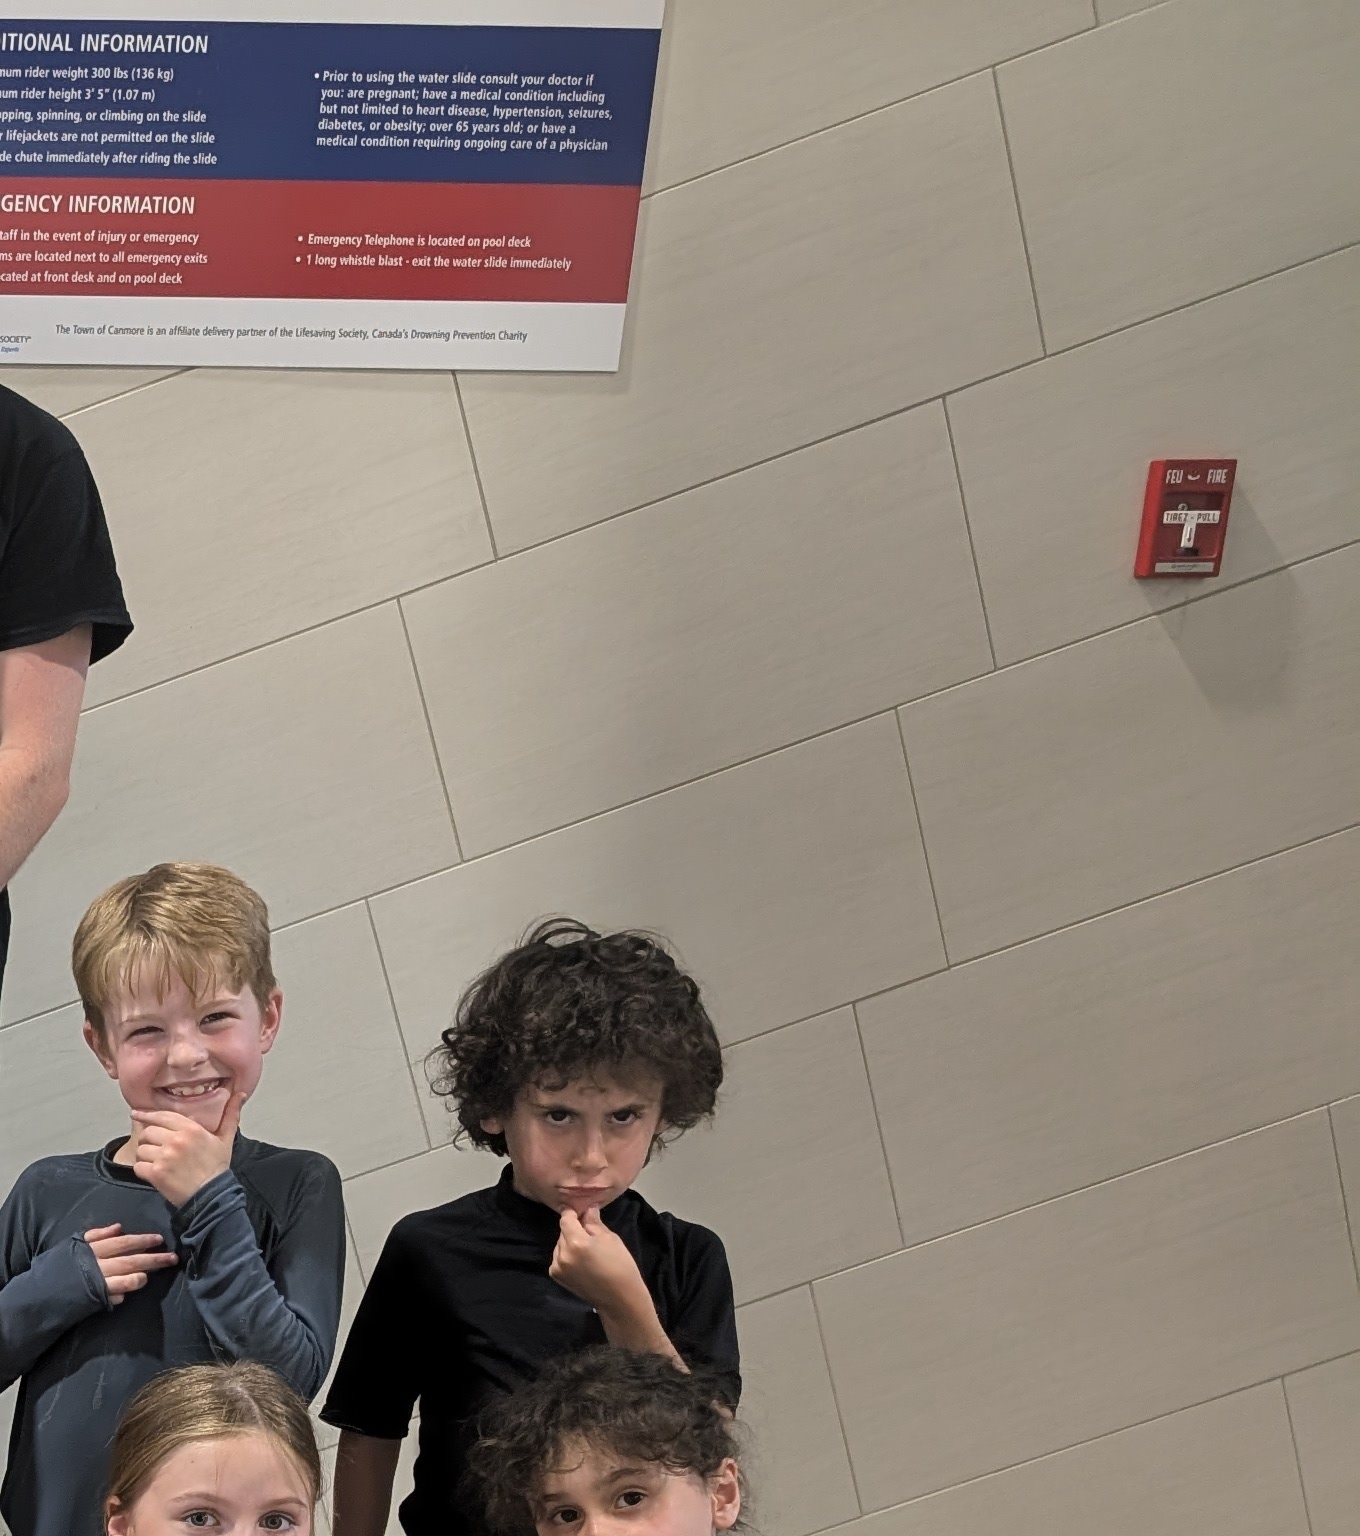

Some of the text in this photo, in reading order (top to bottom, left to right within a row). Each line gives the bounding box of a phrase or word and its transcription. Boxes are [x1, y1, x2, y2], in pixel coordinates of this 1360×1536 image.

[80, 33, 209, 54] INFORMATION
[24, 65, 51, 79] rider
[51, 66, 89, 82] weight
[90, 67, 111, 79] 300
[113, 66, 129, 79] lbs
[131, 67, 155, 82] (136
[156, 67, 174, 83] kg)
[322, 69, 595, 88] Prior to using the water slide consult your doctor if
[20, 87, 47, 100] rider
[48, 87, 83, 103] height
[112, 88, 140, 103] (1.07
[141, 88, 156, 103] m)
[320, 87, 606, 106] you: are pregnant; have a medical condition including
[36, 108, 83, 124] spinning,
[85, 111, 98, 121] or
[99, 108, 144, 125] climbing
[146, 112, 160, 122] on
[162, 110, 180, 122] the
[182, 110, 207, 123] slide
[319, 101, 613, 121] but not limited to heart disease, hypertension, seizures,
[317, 117, 576, 136] diabetes, or obesity; over 65 years old; or have a
[5, 128, 59, 145] lifejackets
[60, 132, 79, 142] are
[80, 131, 99, 143] not
[100, 130, 153, 145] permitted
[154, 133, 169, 143] on
[171, 131, 189, 144] the
[190, 131, 216, 144] slide
[316, 134, 608, 153] medical condition requiring ongoing care of a physician
[14, 150, 44, 163] chute
[45, 150, 111, 167] immediately
[111, 151, 138, 164] after
[139, 151, 171, 167] riding
[173, 152, 191, 165] the
[192, 152, 218, 165] slide
[68, 195, 195, 215] INFORMATION
[20, 229, 31, 241] in
[32, 229, 50, 242] the
[52, 231, 82, 242] event
[83, 229, 96, 242] of
[97, 230, 128, 245] injury
[129, 233, 141, 242] or
[143, 233, 200, 246] emergency
[307, 233, 532, 250] Emergency Telephone is located on pool deck
[15, 252, 32, 262] are
[34, 250, 72, 262] located
[73, 252, 97, 263] next
[98, 251, 110, 263] to
[111, 250, 125, 263] all
[127, 254, 183, 267] emergency
[183, 251, 208, 264] exits
[306, 253, 312, 266] 1
[314, 253, 338, 269] long
[339, 254, 376, 266] whistle
[378, 254, 404, 267] blast
[411, 255, 432, 267] exit
[433, 255, 450, 268] the
[452, 257, 483, 268] water
[483, 255, 508, 268] slide
[509, 256, 572, 272] immediately
[30, 272, 42, 283] at
[43, 270, 70, 283] front
[71, 270, 95, 283] desk
[96, 271, 117, 283] and
[118, 274, 132, 284] on
[133, 272, 157, 286] pool
[158, 272, 183, 284] deck
[1165, 469, 1229, 484] FEU FIRE
